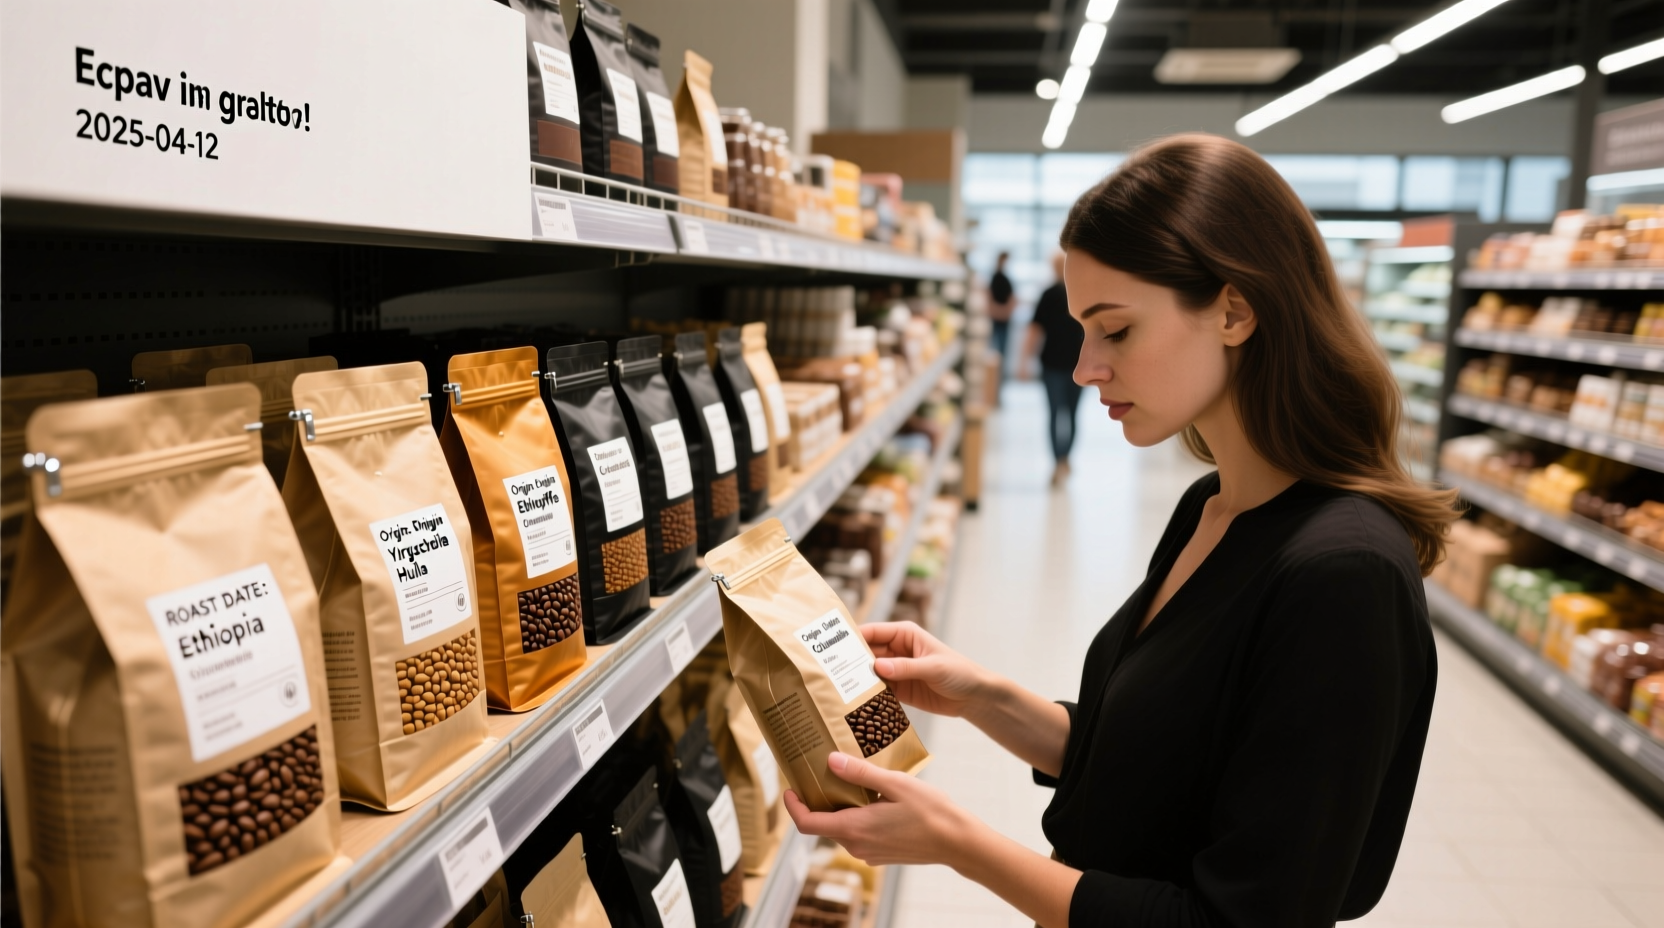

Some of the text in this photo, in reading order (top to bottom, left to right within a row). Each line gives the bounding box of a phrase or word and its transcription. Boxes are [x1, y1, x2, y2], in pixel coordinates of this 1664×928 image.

[75, 46, 171, 102] Ecpav
[76, 108, 219, 160] 2025-04-12
[165, 581, 269, 627] ROAST DATE:
[178, 612, 265, 660] Ethiopia
